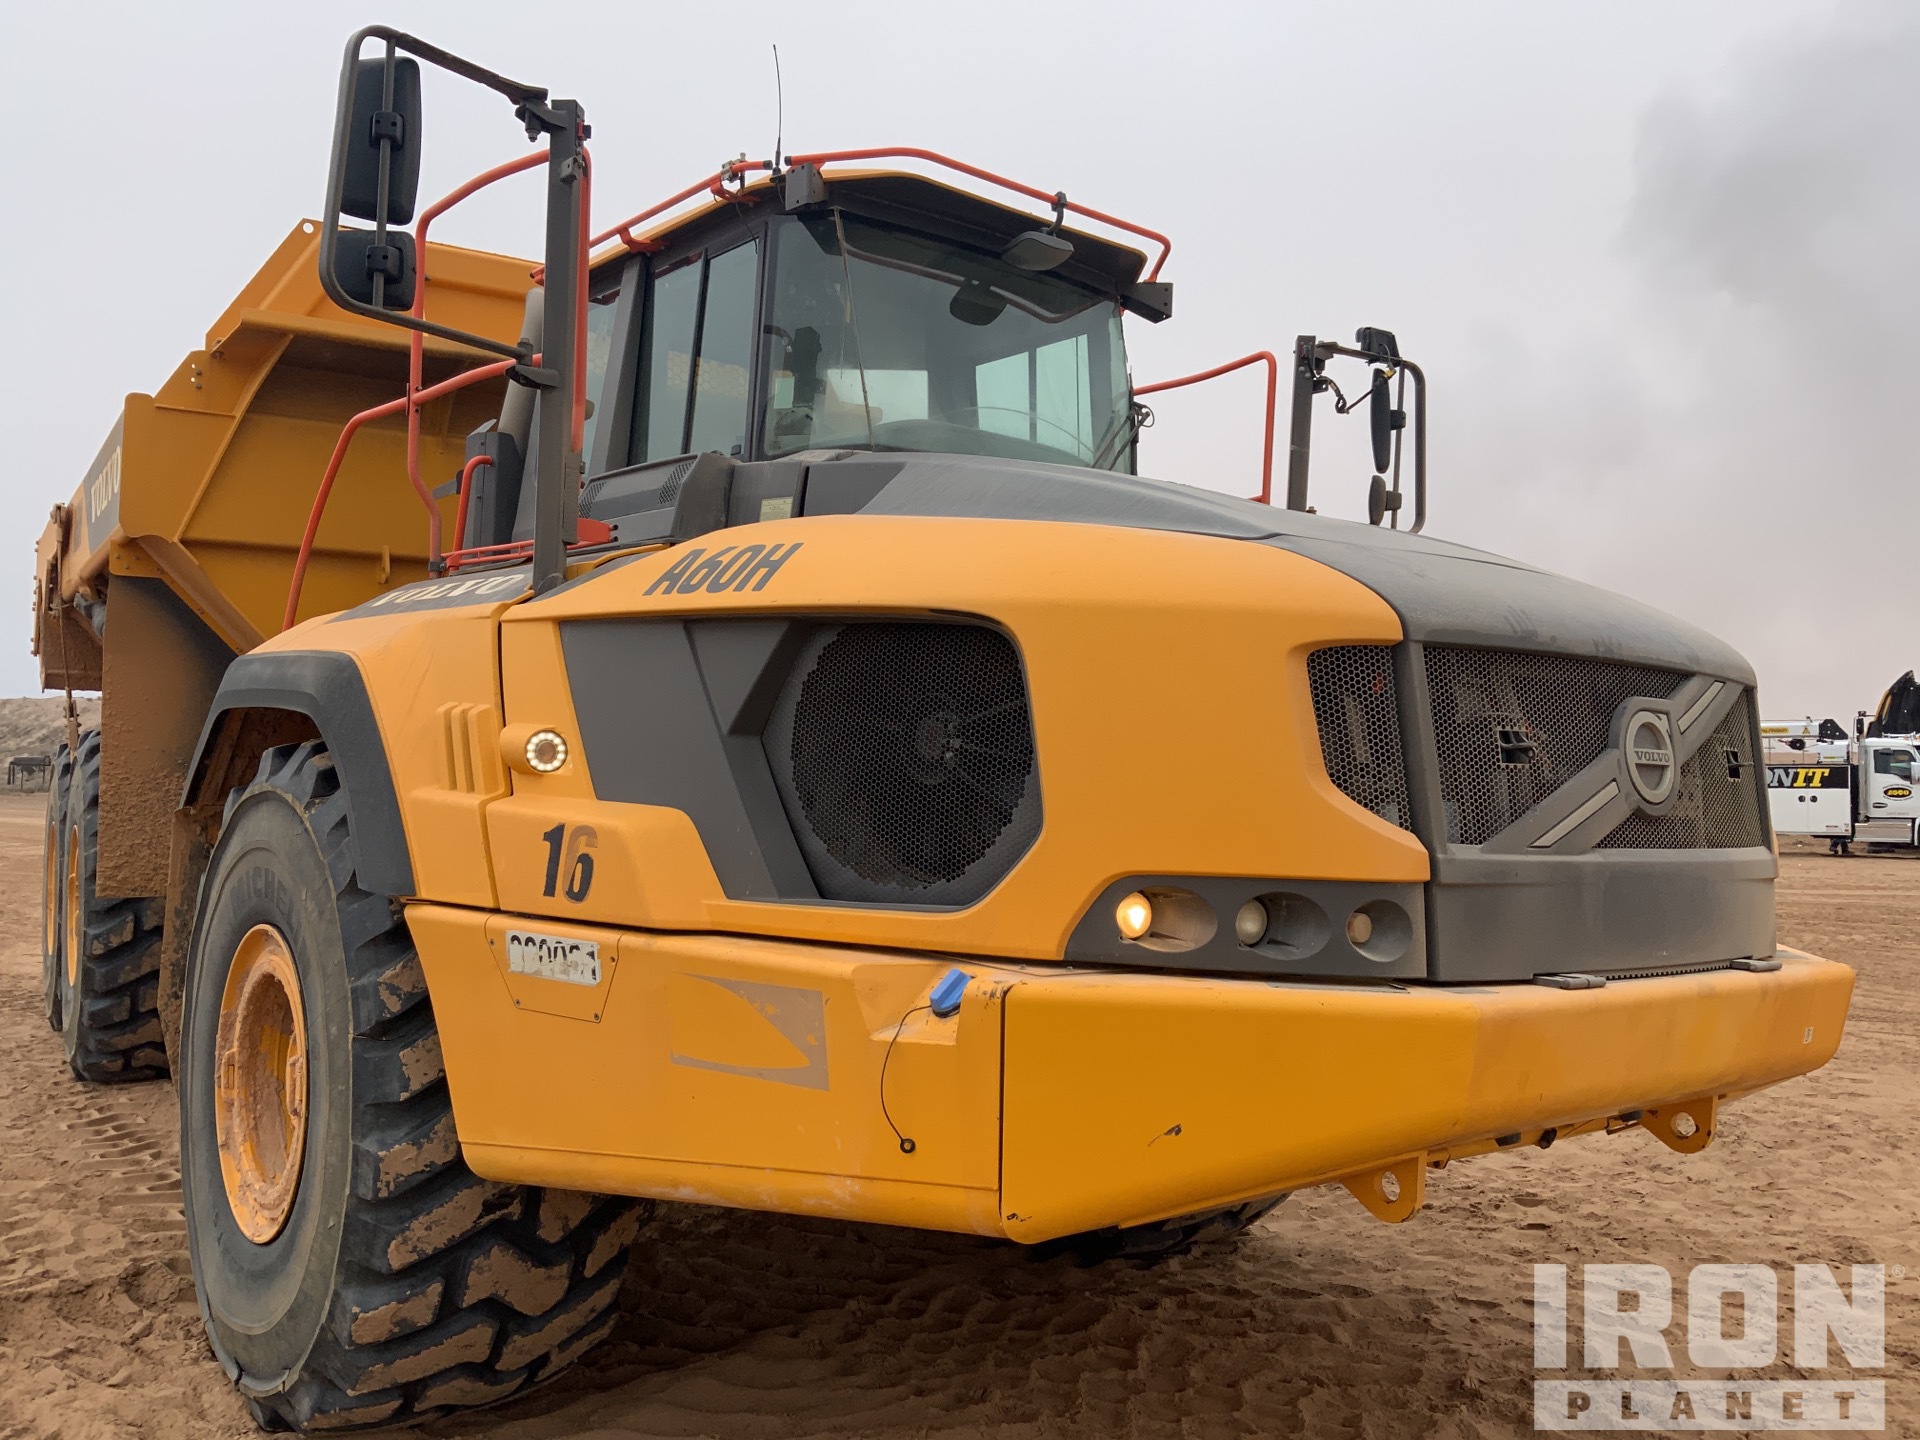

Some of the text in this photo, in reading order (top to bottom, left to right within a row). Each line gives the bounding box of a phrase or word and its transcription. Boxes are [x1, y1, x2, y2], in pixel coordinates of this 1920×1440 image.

[91, 445, 121, 523] VOLVO
[371, 573, 525, 608] VOLVO
[642, 541, 804, 597] A60H
[1634, 751, 1670, 763] VOLVO
[542, 822, 599, 904] 16
